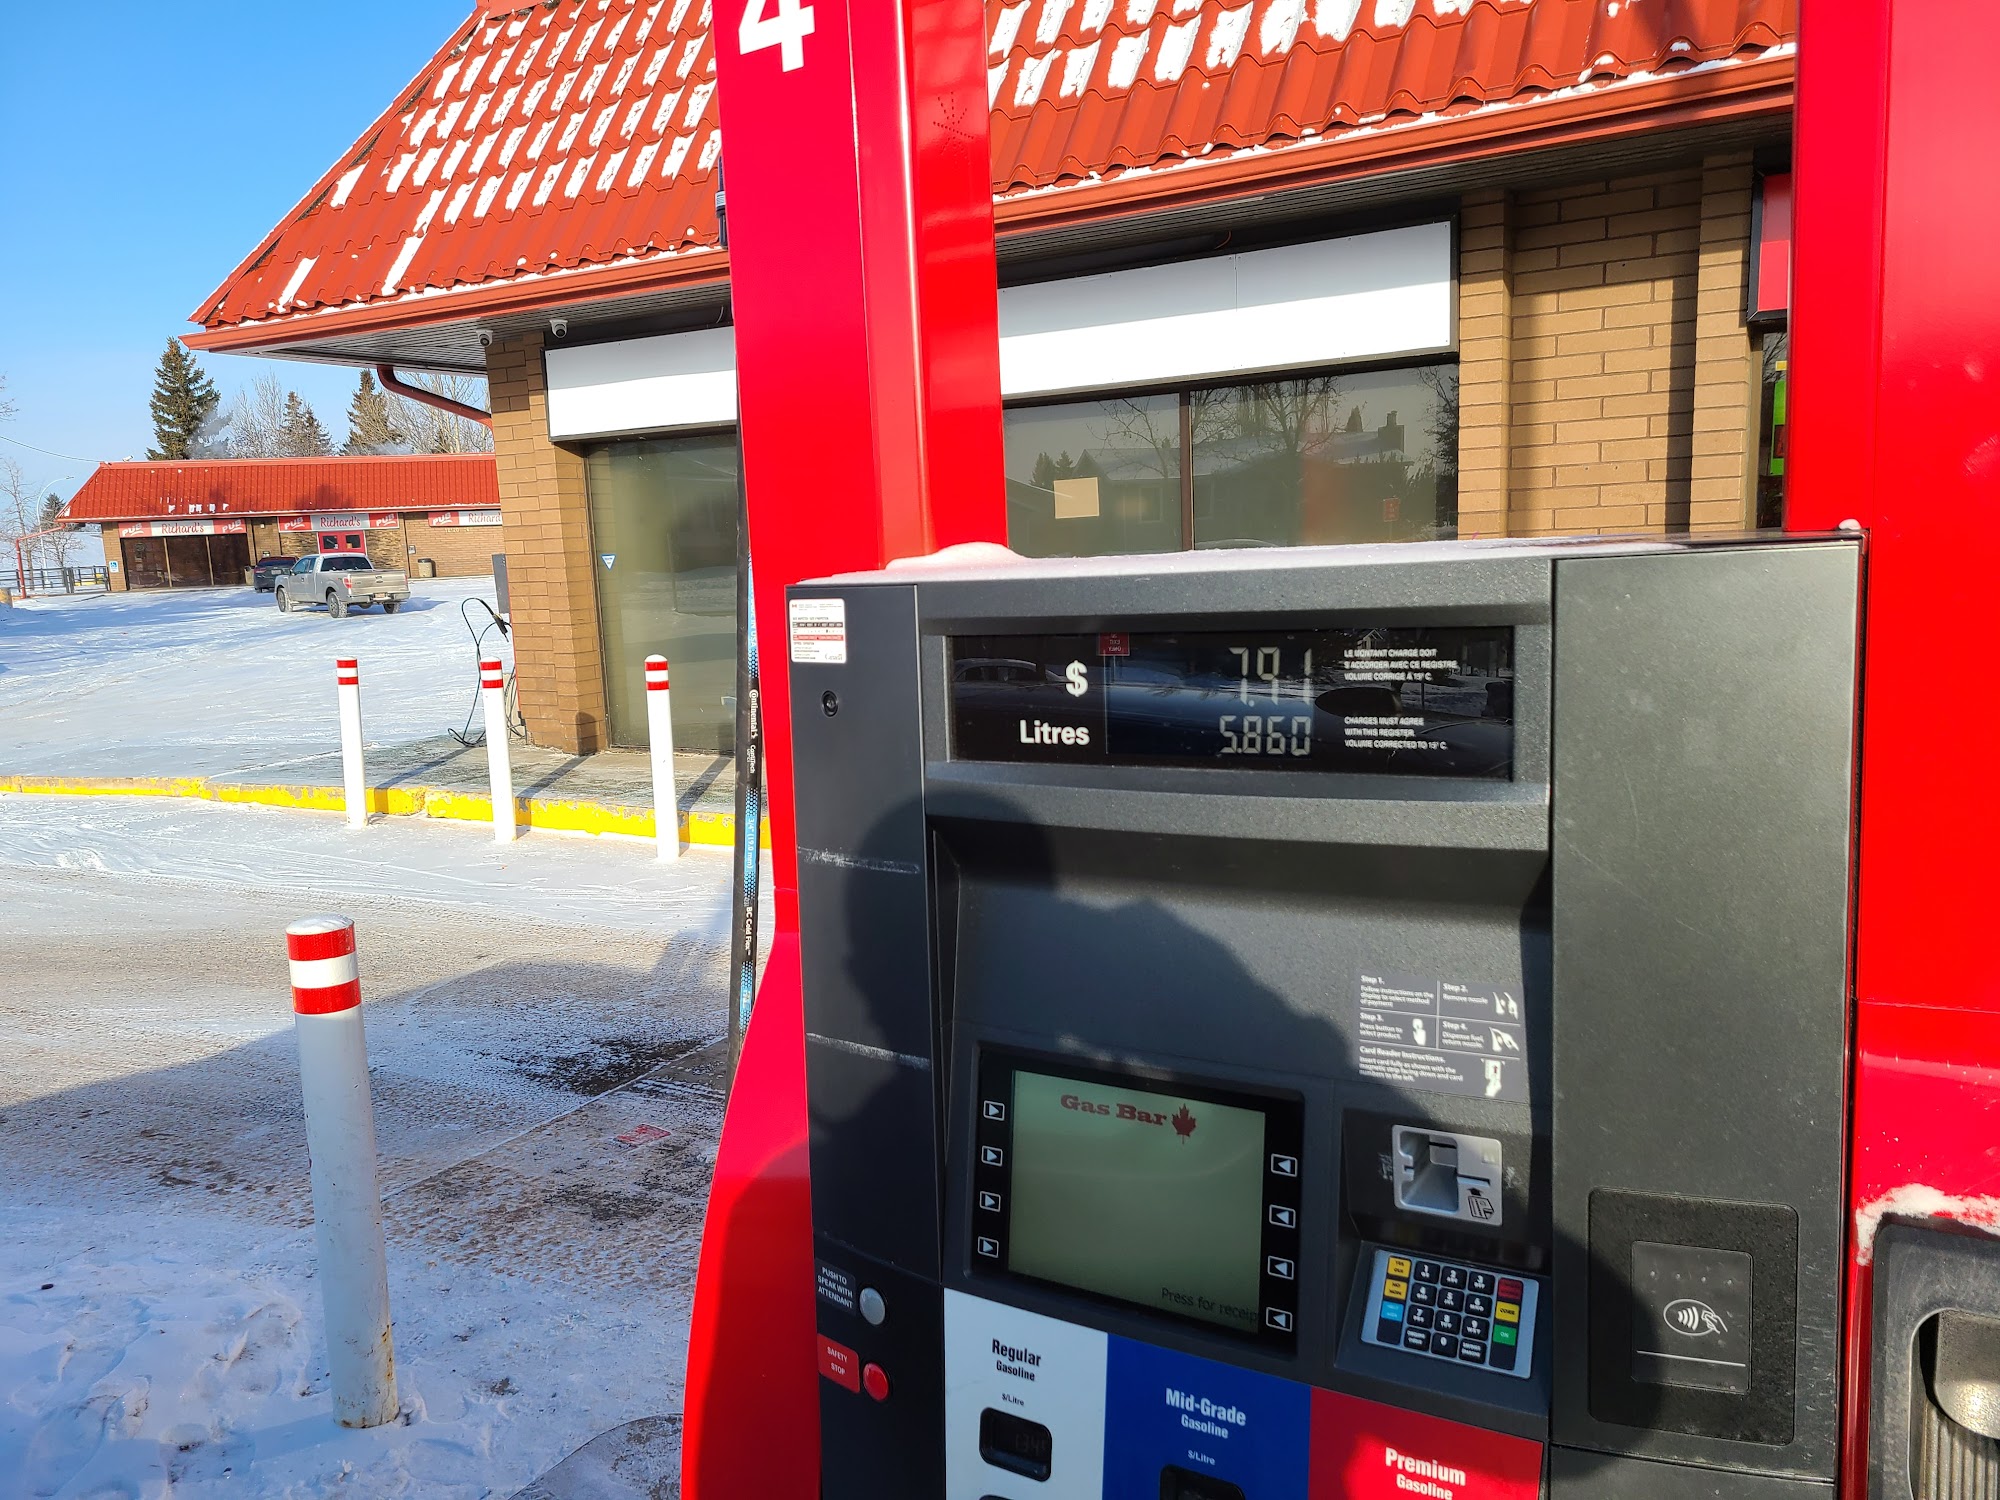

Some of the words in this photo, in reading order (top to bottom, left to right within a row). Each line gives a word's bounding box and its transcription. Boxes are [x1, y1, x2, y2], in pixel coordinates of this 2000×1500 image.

[739, 0, 815, 72] 4
[284, 516, 304, 530] PUB
[320, 516, 360, 527] Richard's
[376, 514, 395, 527] PUB
[432, 512, 451, 526] PUB
[468, 512, 501, 523] Richard
[122, 523, 143, 537] PUB
[162, 522, 204, 534] Richard's
[222, 519, 242, 533] PUB
[1344, 648, 1353, 658] LE
[1354, 648, 1387, 658] MONTANT
[1419, 648, 1438, 658] DOIT
[1390, 660, 1409, 669] AVEC
[1410, 660, 1420, 669] CE
[1066, 660, 1088, 697] $
[1344, 672, 1373, 680] VOLUME
[749, 689, 758, 732] Continental
[1344, 716, 1378, 725] CHARGES
[1379, 716, 1399, 725] MUST
[1399, 717, 1424, 726] AGREE
[1020, 720, 1090, 746] Litres
[1344, 728, 1362, 736] WITH
[1362, 728, 1378, 736] THIS
[1344, 740, 1373, 748] VOLUME
[1374, 740, 1417, 749] CORRECTED
[1417, 741, 1428, 750] TO
[746, 906, 752, 918] BC
[1361, 975, 1377, 985] Step
[1380, 987, 1414, 996] instructions
[1443, 983, 1460, 993] Step
[1360, 992, 1380, 1000] display
[1443, 993, 1467, 1002] Remove
[1360, 1012, 1376, 1022] Step
[1375, 1024, 1395, 1032] button
[1442, 1021, 1459, 1031] Step
[1442, 1031, 1470, 1040] Dispense
[1360, 1046, 1376, 1055] Card
[1376, 1048, 1401, 1058] Reader
[1359, 1063, 1386, 1072] magnetic
[1360, 1056, 1376, 1064] Insert
[1390, 1059, 1402, 1068] fully
[1411, 1063, 1431, 1071] shown
[1359, 1070, 1384, 1078] numbers
[1060, 1094, 1110, 1115] Gas
[1116, 1103, 1168, 1126] Bar
[822, 1266, 838, 1281] PUSH
[838, 1275, 847, 1286] TO
[818, 1275, 836, 1290] SPEAK
[837, 1286, 853, 1298] WITH
[818, 1286, 853, 1309] ATTENDANT
[1161, 1287, 1194, 1306] Press
[1198, 1296, 1215, 1311] for
[1219, 1304, 1259, 1323] receip
[827, 1346, 847, 1363] SAFETY
[992, 1338, 1041, 1367] Regular
[830, 1362, 845, 1375] STOP
[996, 1360, 1035, 1382] Gasoline
[1002, 1393, 1024, 1406] $/Litre
[1166, 1388, 1246, 1426] Mid-Grade
[1181, 1414, 1228, 1439] Gasoline
[1188, 1449, 1216, 1466] $/Litre
[1386, 1446, 1466, 1486] Premium
[1396, 1473, 1453, 1500] Gasoline
